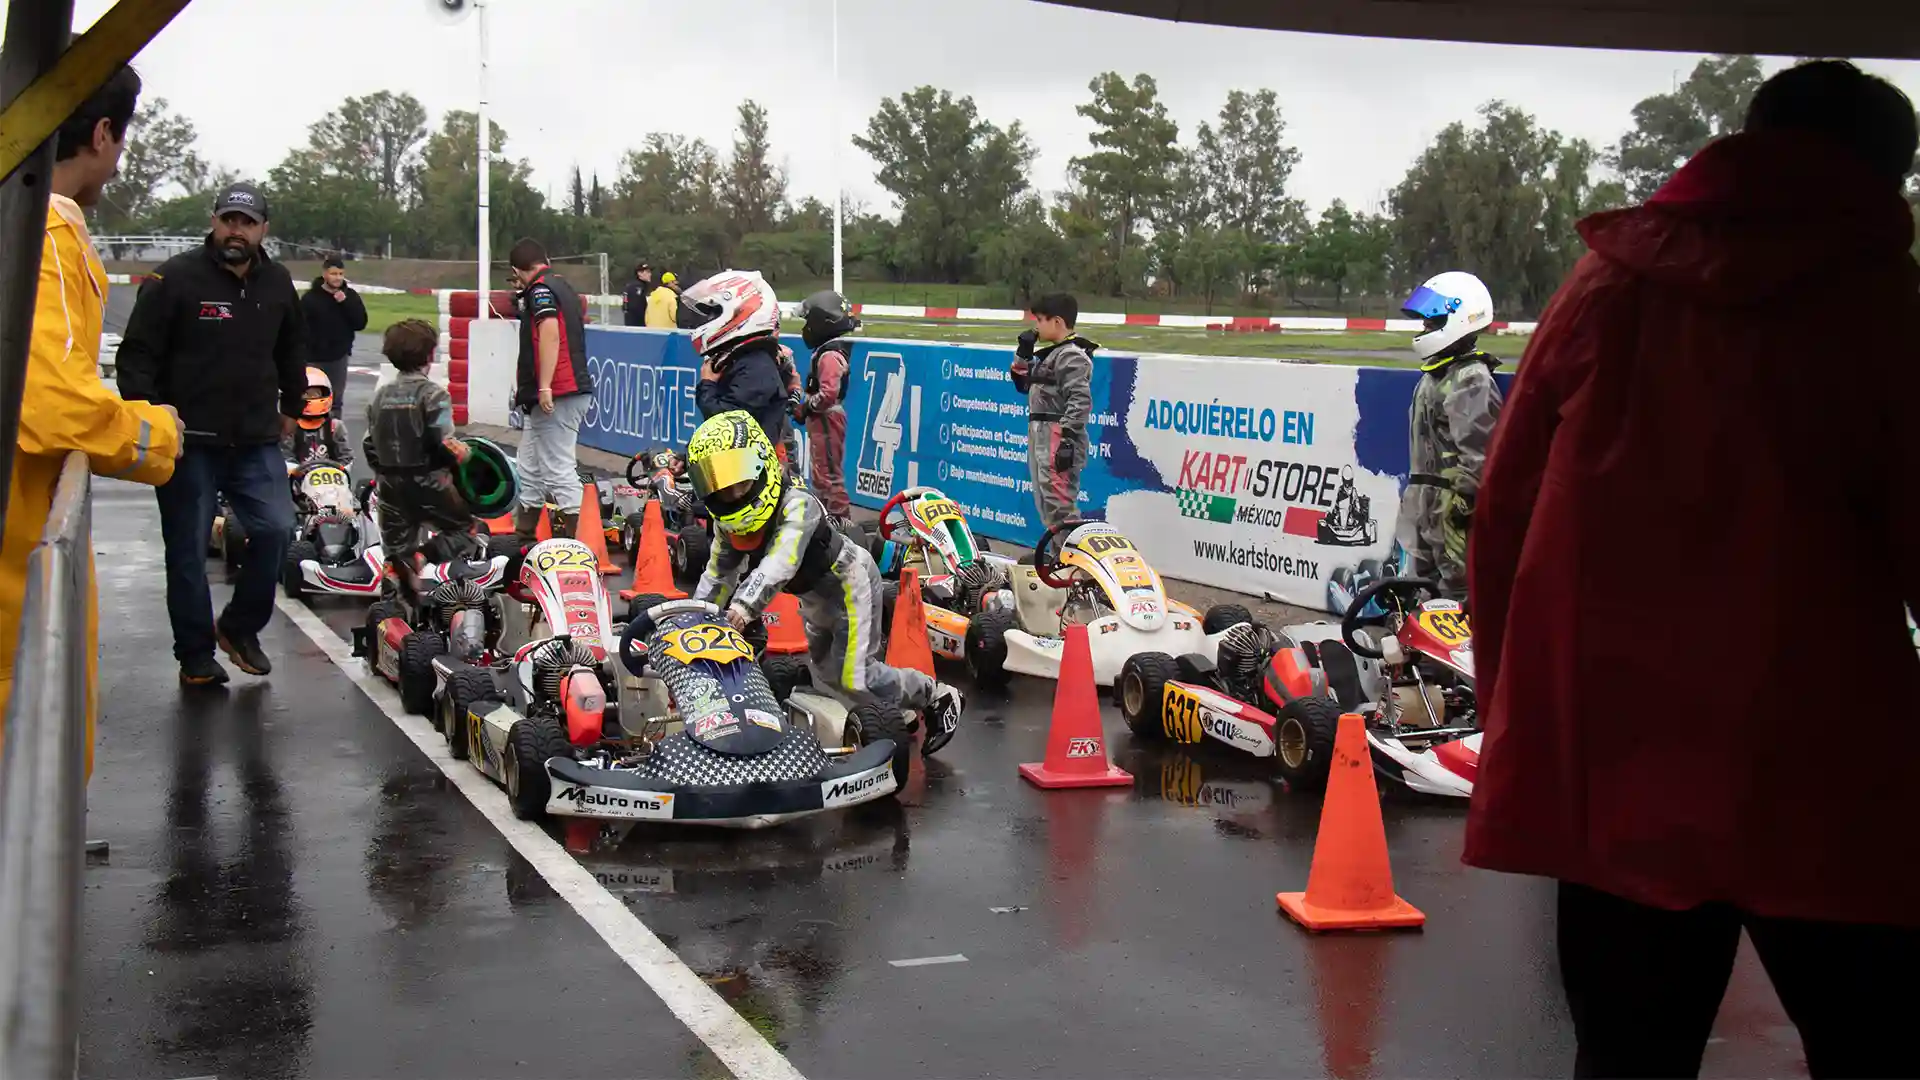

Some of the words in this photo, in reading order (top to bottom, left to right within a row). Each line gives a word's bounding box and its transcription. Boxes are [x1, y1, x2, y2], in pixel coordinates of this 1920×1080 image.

[954, 363, 973, 378] Pocas
[974, 366, 1004, 381] variables
[952, 394, 998, 412] Competencias
[999, 401, 1024, 418] parejas
[1144, 398, 1276, 442] ADQUIÉRELO
[1282, 410, 1315, 445] EN
[994, 431, 1003, 443] en
[951, 441, 956, 454] y
[956, 439, 997, 457] Campeonato
[998, 445, 1028, 464] Nacional
[1099, 442, 1112, 458] FK
[309, 472, 345, 486] 698
[857, 471, 891, 497] SERIES
[950, 463, 965, 481] Bajo
[965, 469, 1015, 489] mantenimiento
[1178, 449, 1248, 494] KART
[1253, 459, 1340, 507] STORE
[972, 503, 980, 517] de
[981, 506, 994, 521] alta
[1236, 503, 1282, 528] MÉXICO
[537, 549, 596, 572] 622
[1193, 539, 1319, 580] www.kartstore.mx
[679, 625, 752, 656] 626
[1164, 689, 1197, 744] 637
[1214, 719, 1236, 740] CIU
